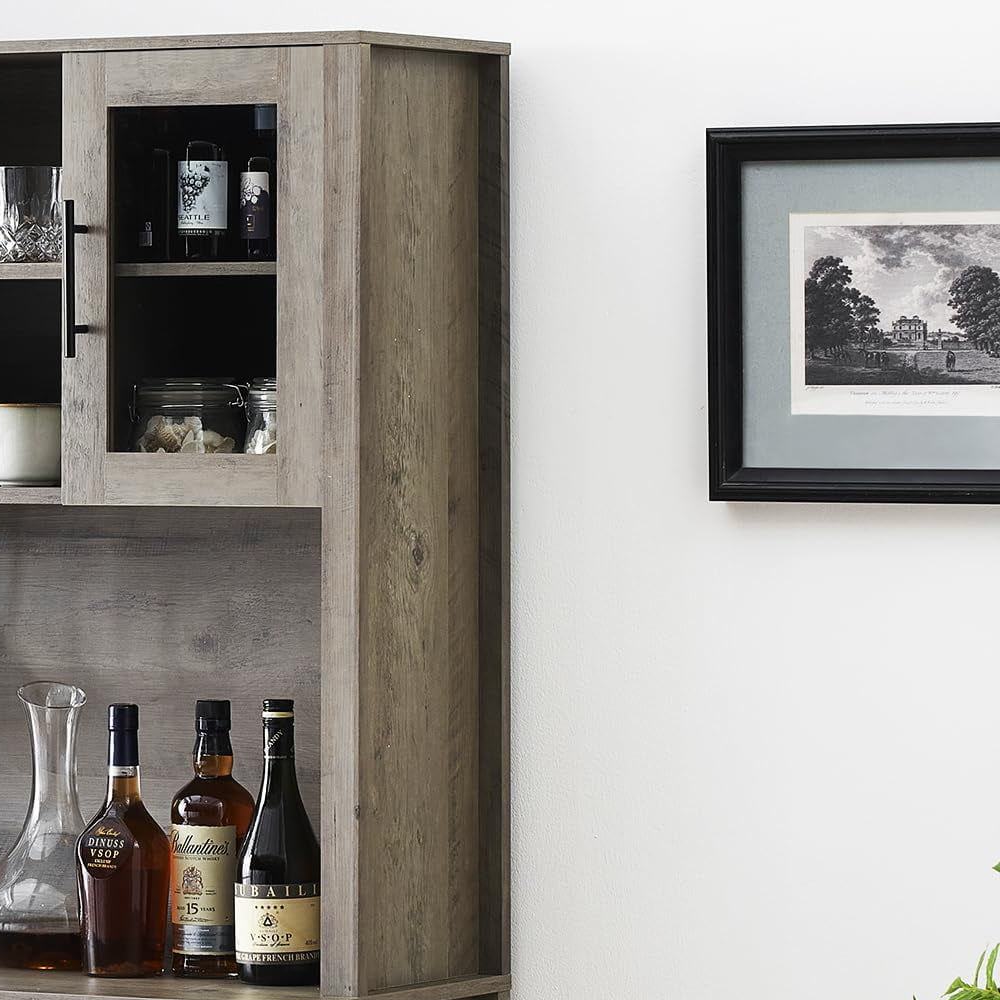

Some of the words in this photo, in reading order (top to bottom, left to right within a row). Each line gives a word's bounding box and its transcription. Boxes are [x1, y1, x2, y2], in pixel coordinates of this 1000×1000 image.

[88, 837, 125, 848] DINUSS
[90, 848, 119, 859] VSOP
[187, 903, 199, 915] 15
[262, 952, 295, 963] FRENCH
